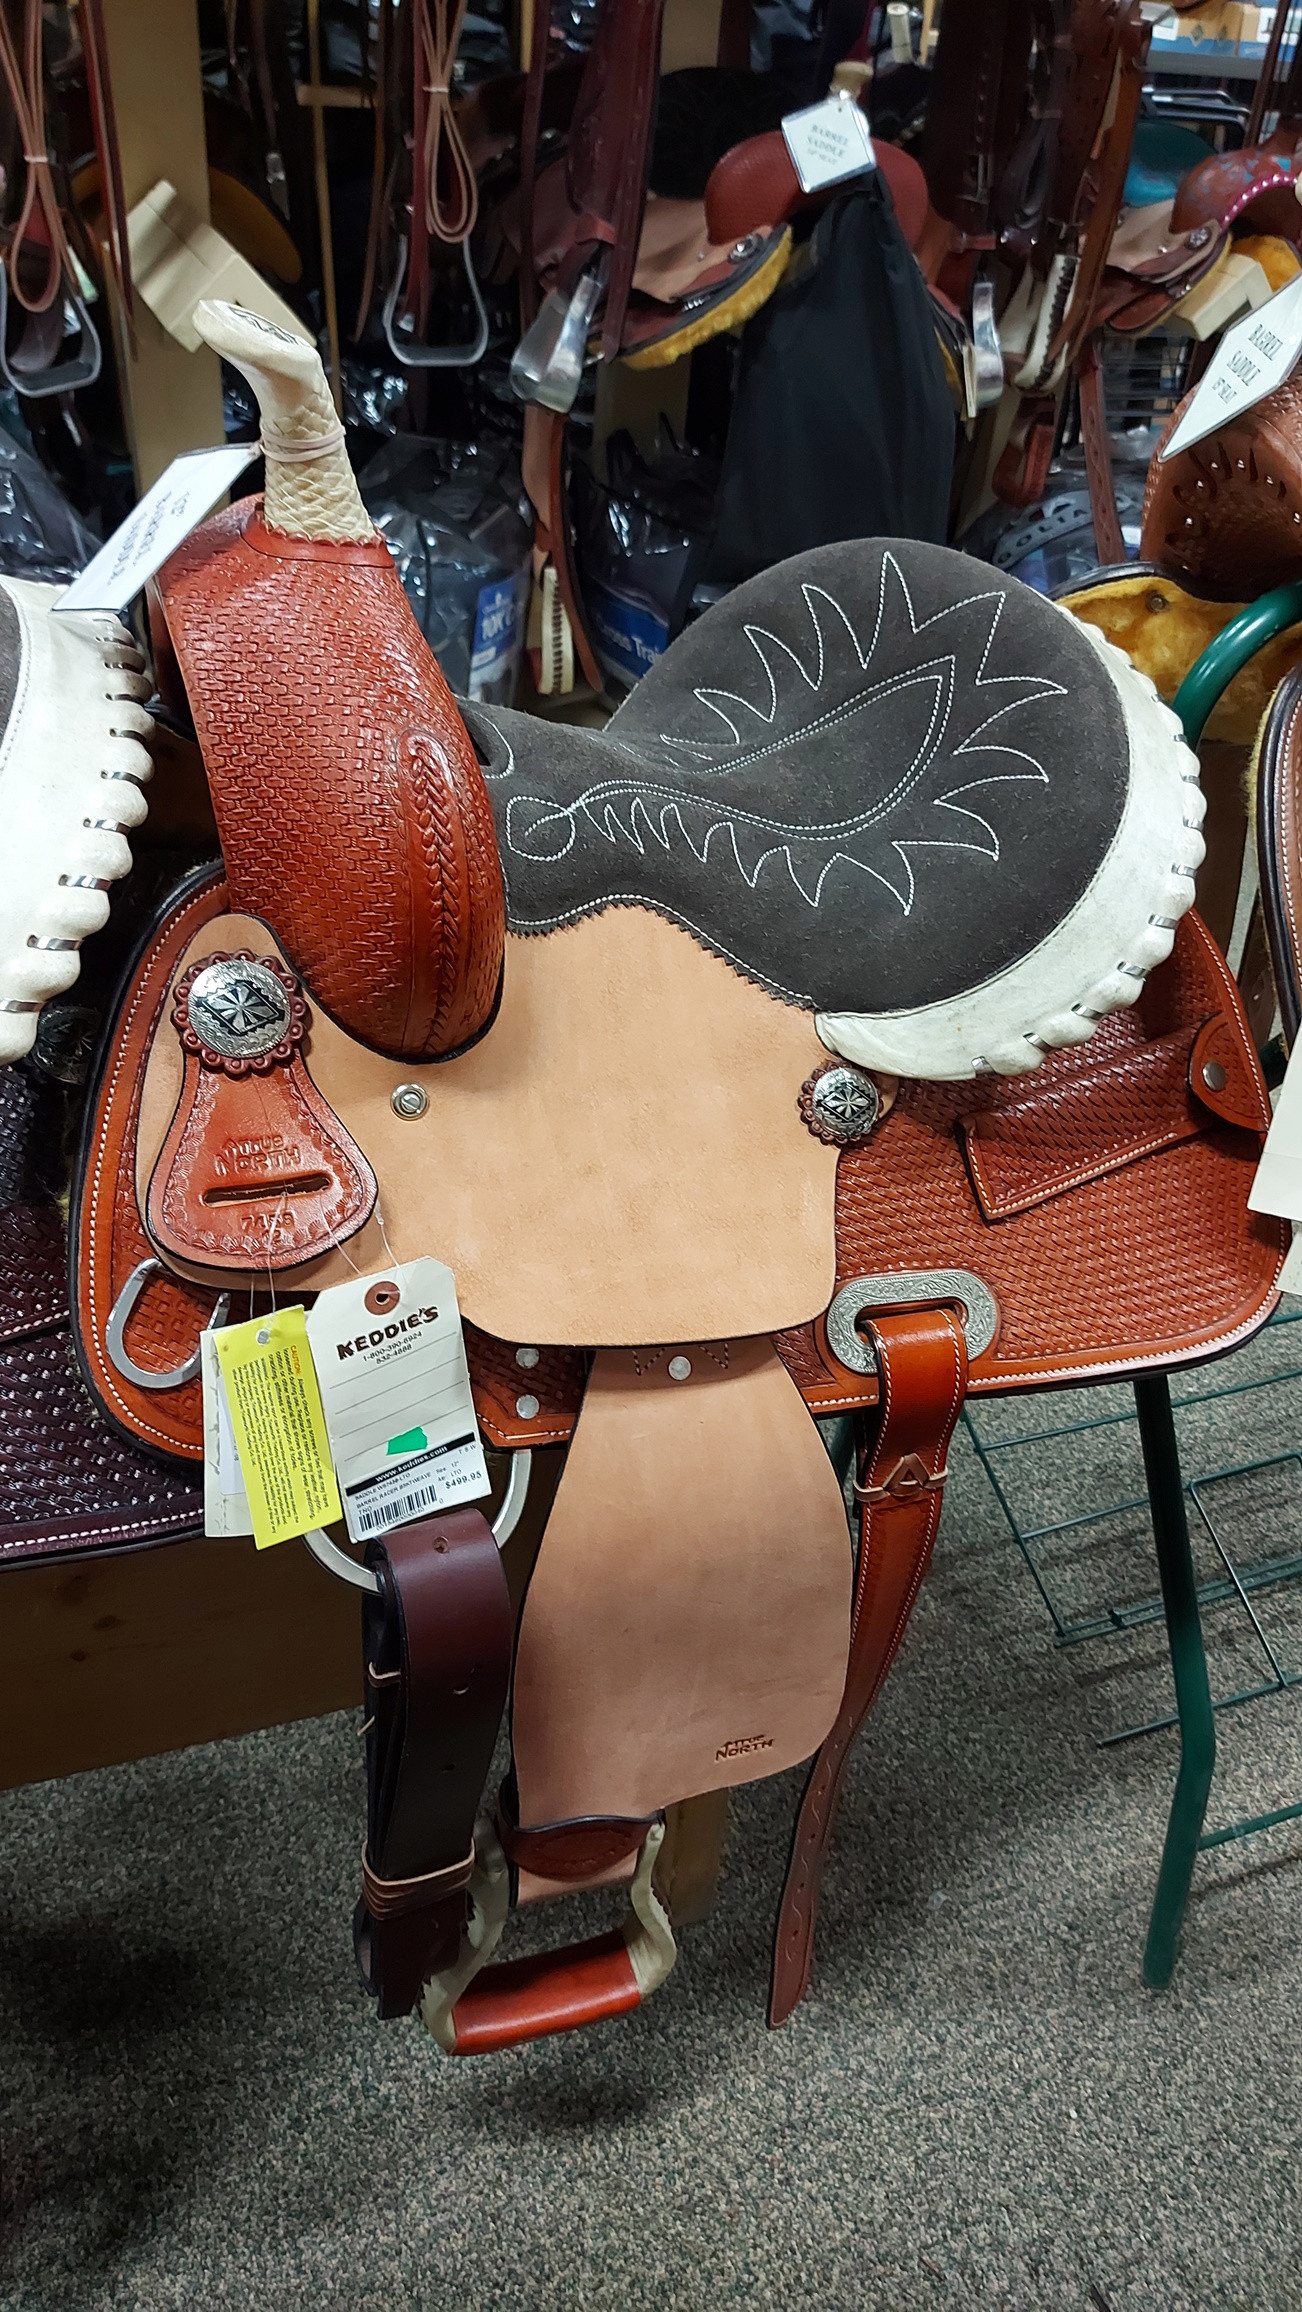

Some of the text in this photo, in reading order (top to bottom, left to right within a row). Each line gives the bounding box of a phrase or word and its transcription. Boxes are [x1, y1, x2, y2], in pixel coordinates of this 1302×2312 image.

[214, 1143, 303, 1176] NORTH
[336, 1306, 439, 1360] KEDDIE'S
[375, 1446, 447, 1482] www.keddies.com
[445, 1470, 482, 1489] $499.95
[714, 1738, 776, 1761] NORTH
